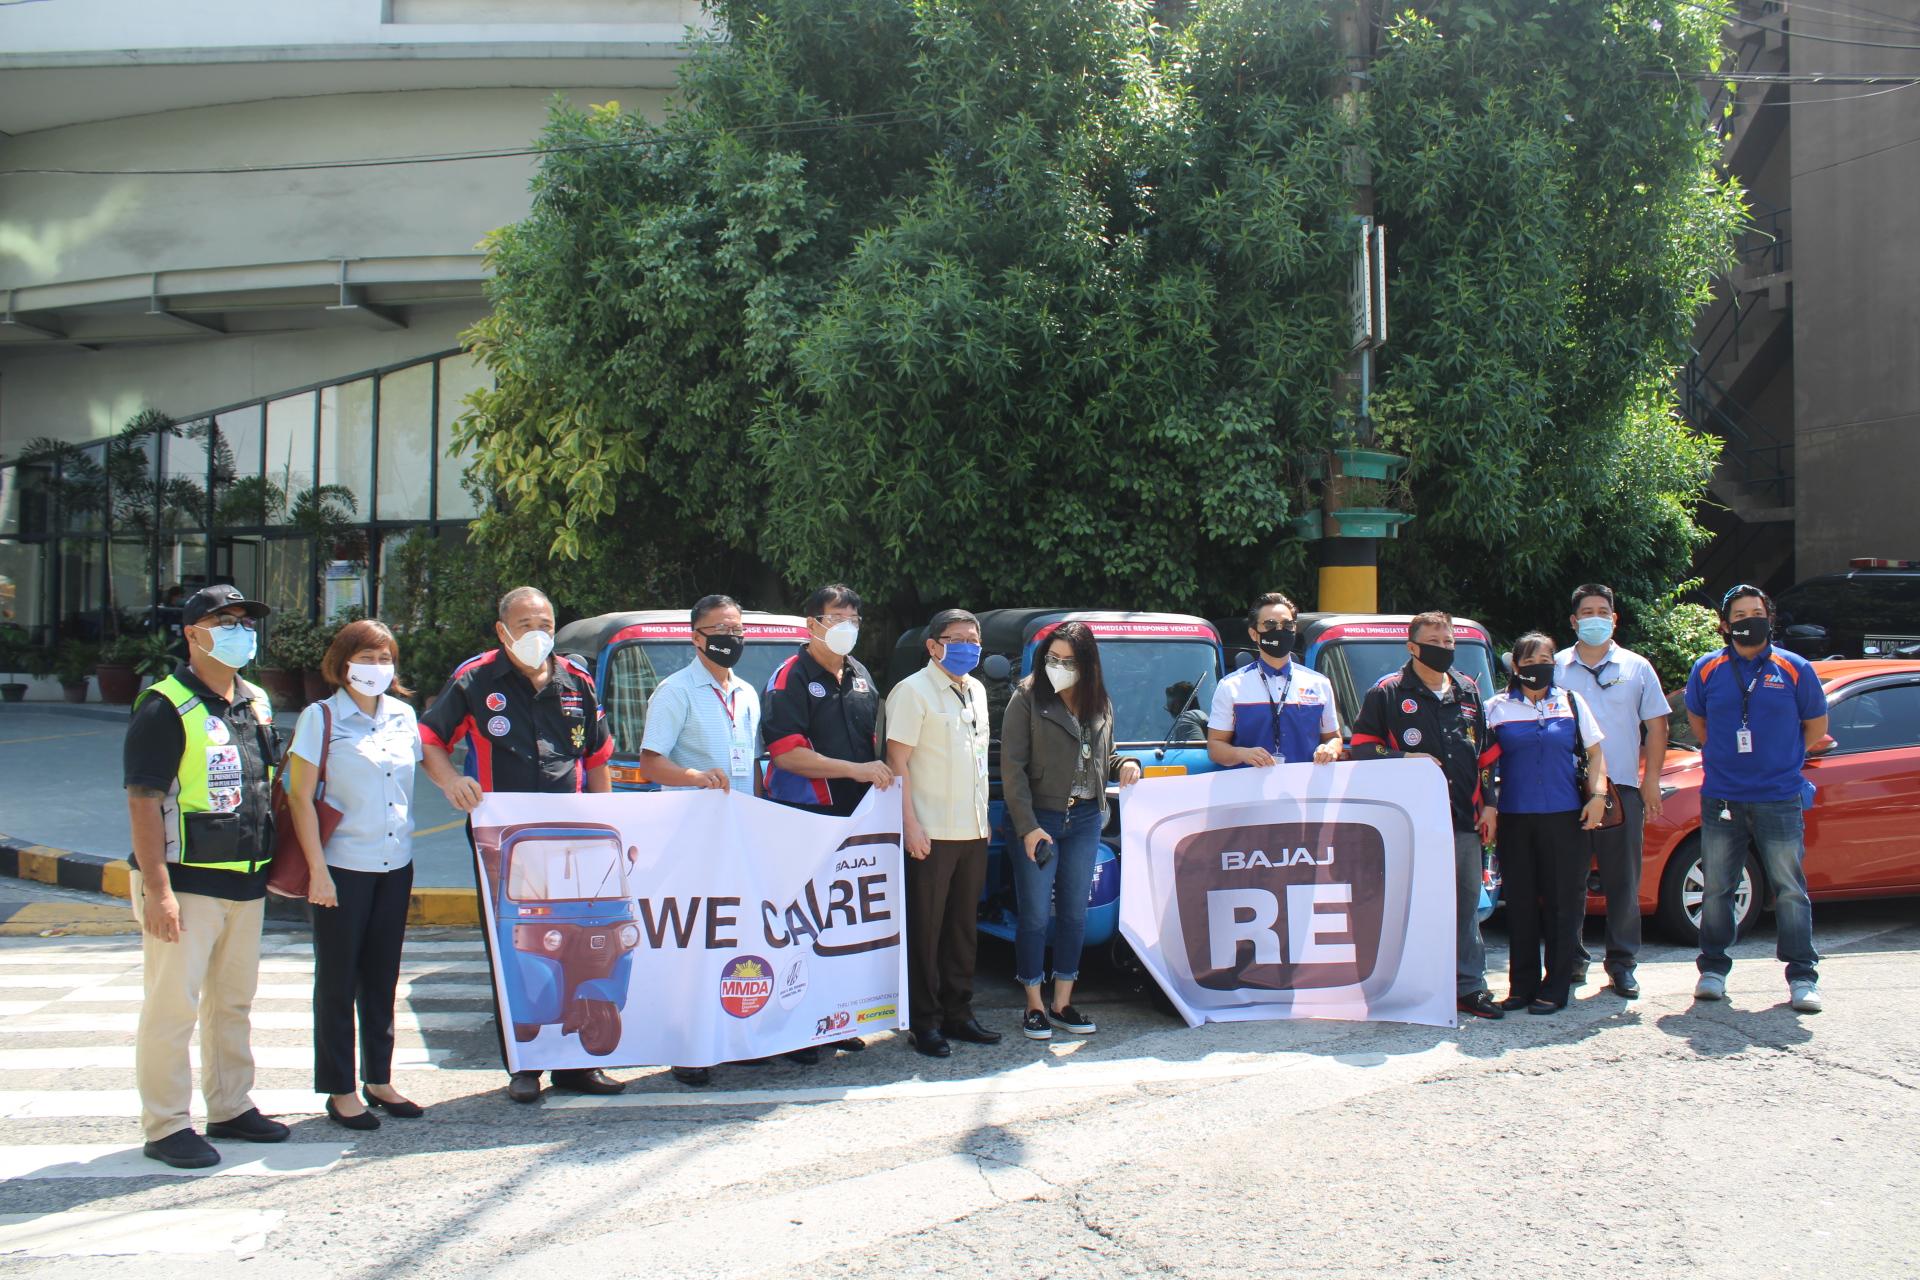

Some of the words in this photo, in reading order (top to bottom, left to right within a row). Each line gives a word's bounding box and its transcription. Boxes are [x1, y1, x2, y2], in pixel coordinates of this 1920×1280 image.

[836, 856, 876, 872] BAJAJ
[1221, 846, 1334, 870] BAJAJ
[638, 896, 741, 950] WE
[1206, 883, 1356, 970] RE
[722, 980, 768, 996] MMDA
[859, 994, 892, 1004] COORDINATION
